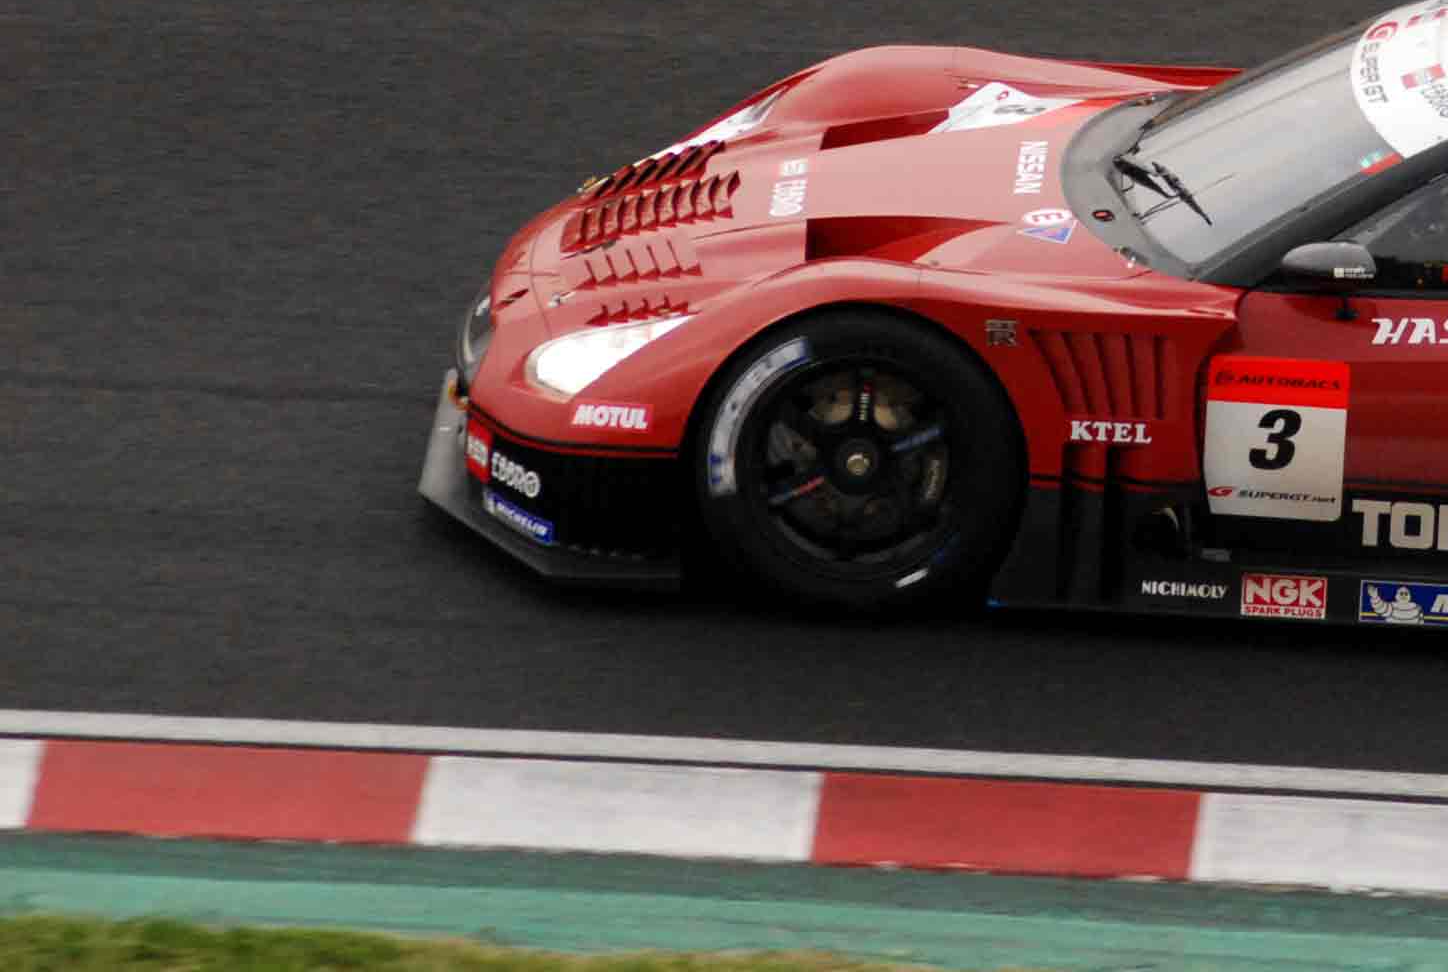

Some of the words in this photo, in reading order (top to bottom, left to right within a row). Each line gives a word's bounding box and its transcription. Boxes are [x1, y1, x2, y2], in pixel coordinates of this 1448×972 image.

[1012, 140, 1049, 195] NISSAN
[572, 404, 648, 430] MOTUL
[1070, 420, 1152, 444] KTEL
[1248, 409, 1302, 470] 3
[1245, 578, 1323, 607] NGK
